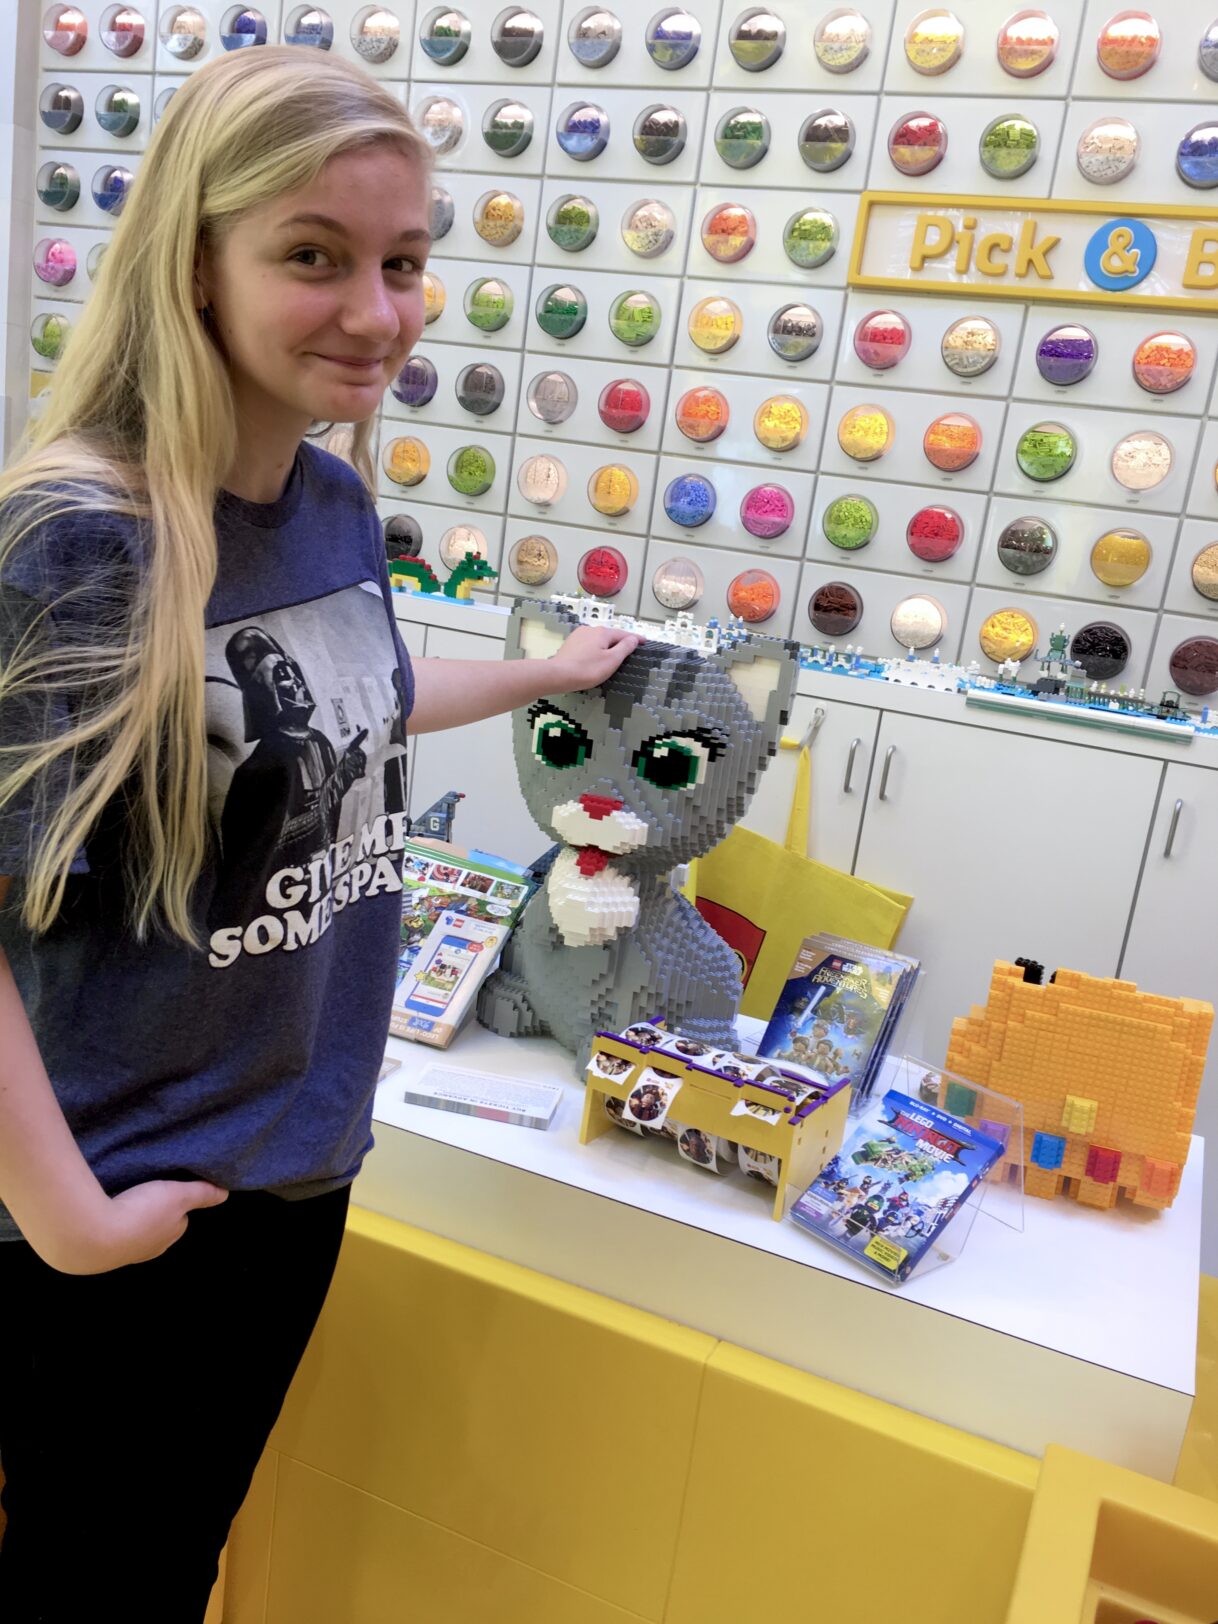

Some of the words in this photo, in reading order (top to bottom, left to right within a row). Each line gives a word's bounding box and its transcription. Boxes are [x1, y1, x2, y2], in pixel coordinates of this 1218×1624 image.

[909, 215, 1061, 280] Pick
[1101, 227, 1141, 277] &
[430, 817, 439, 831] G
[909, 1112, 934, 1129] LEGO
[915, 1139, 954, 1164] MOVIE
